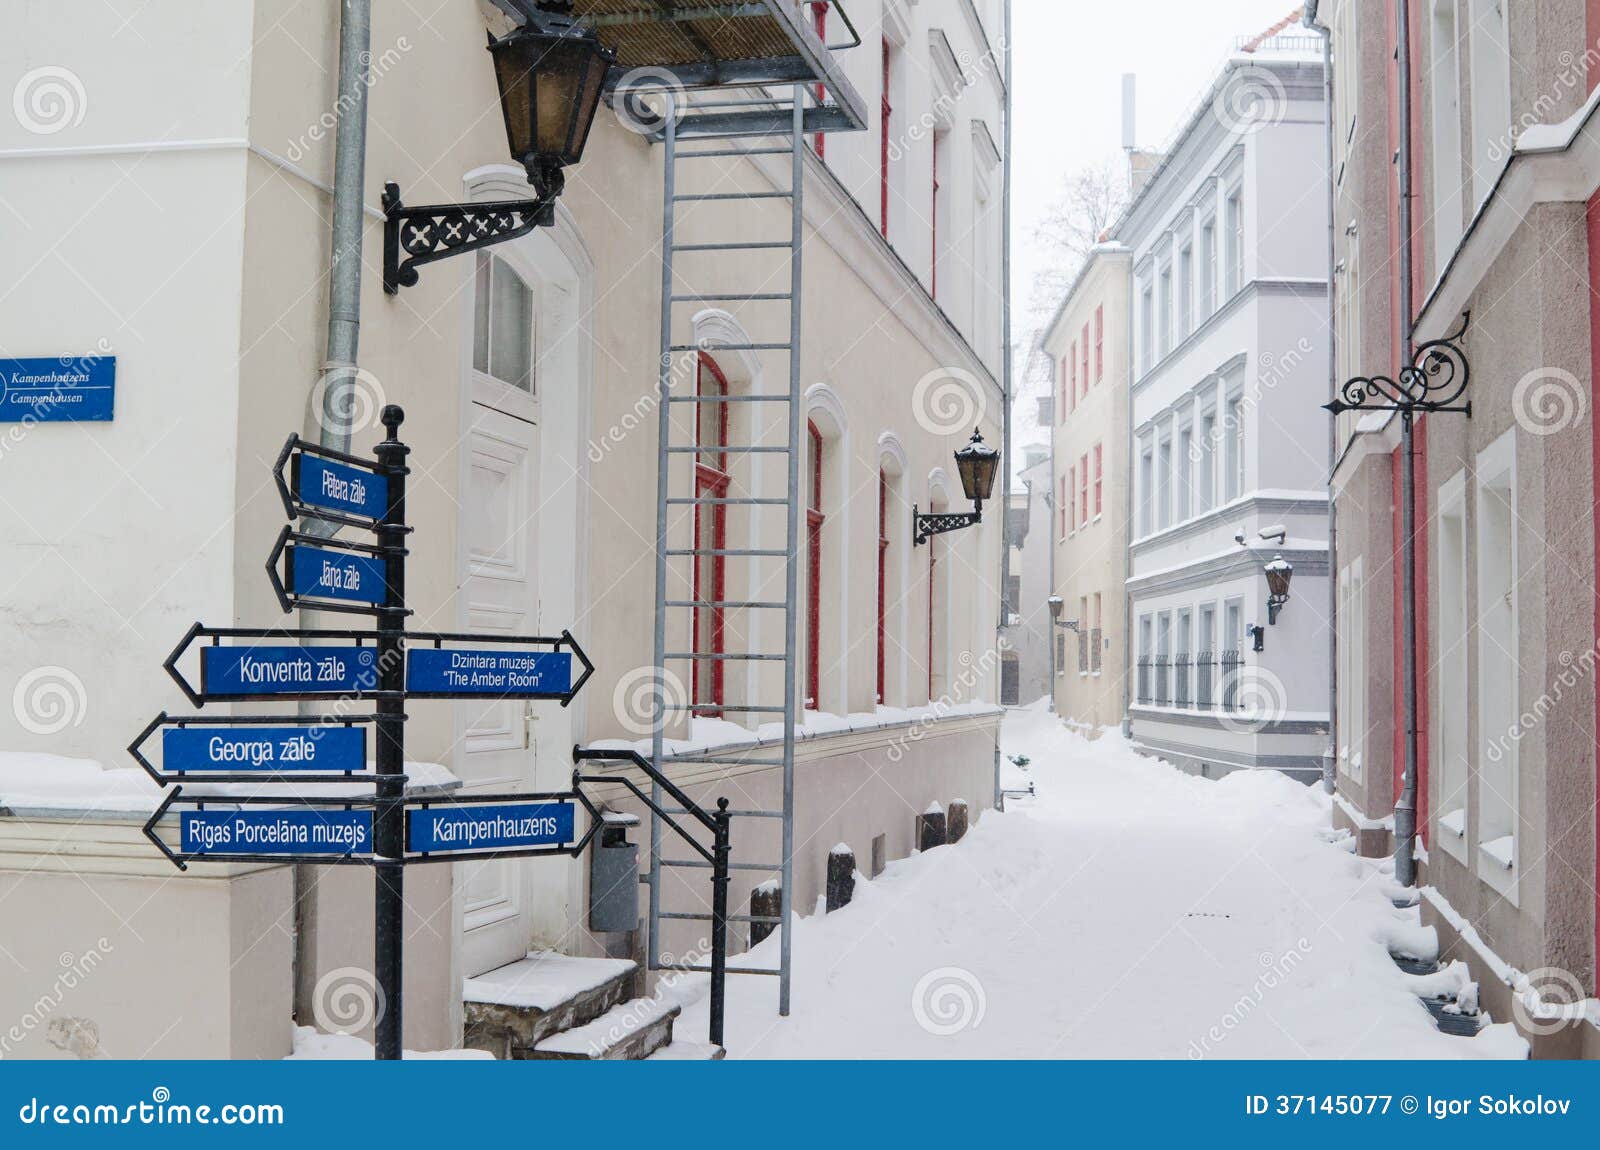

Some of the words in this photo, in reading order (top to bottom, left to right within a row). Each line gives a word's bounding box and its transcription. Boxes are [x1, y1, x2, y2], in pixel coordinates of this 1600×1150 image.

[11, 371, 90, 386] Kampenhauzens
[10, 392, 82, 407] Campenhausen
[322, 469, 348, 501] Pētera
[350, 479, 366, 505] zāle
[319, 560, 342, 593] Jāņa
[343, 564, 360, 590] zāle
[240, 656, 312, 683] Konventa
[317, 656, 345, 682] zāle
[451, 653, 496, 669] Dzintara
[499, 655, 536, 673] muzejs
[470, 671, 505, 687] Amber
[209, 736, 274, 766] Georga
[279, 736, 315, 761] zāle
[189, 819, 231, 848] Rīgas
[235, 819, 308, 843] Porcelāna
[312, 819, 365, 849] muzejs
[433, 815, 557, 845] Kampenhauzens
